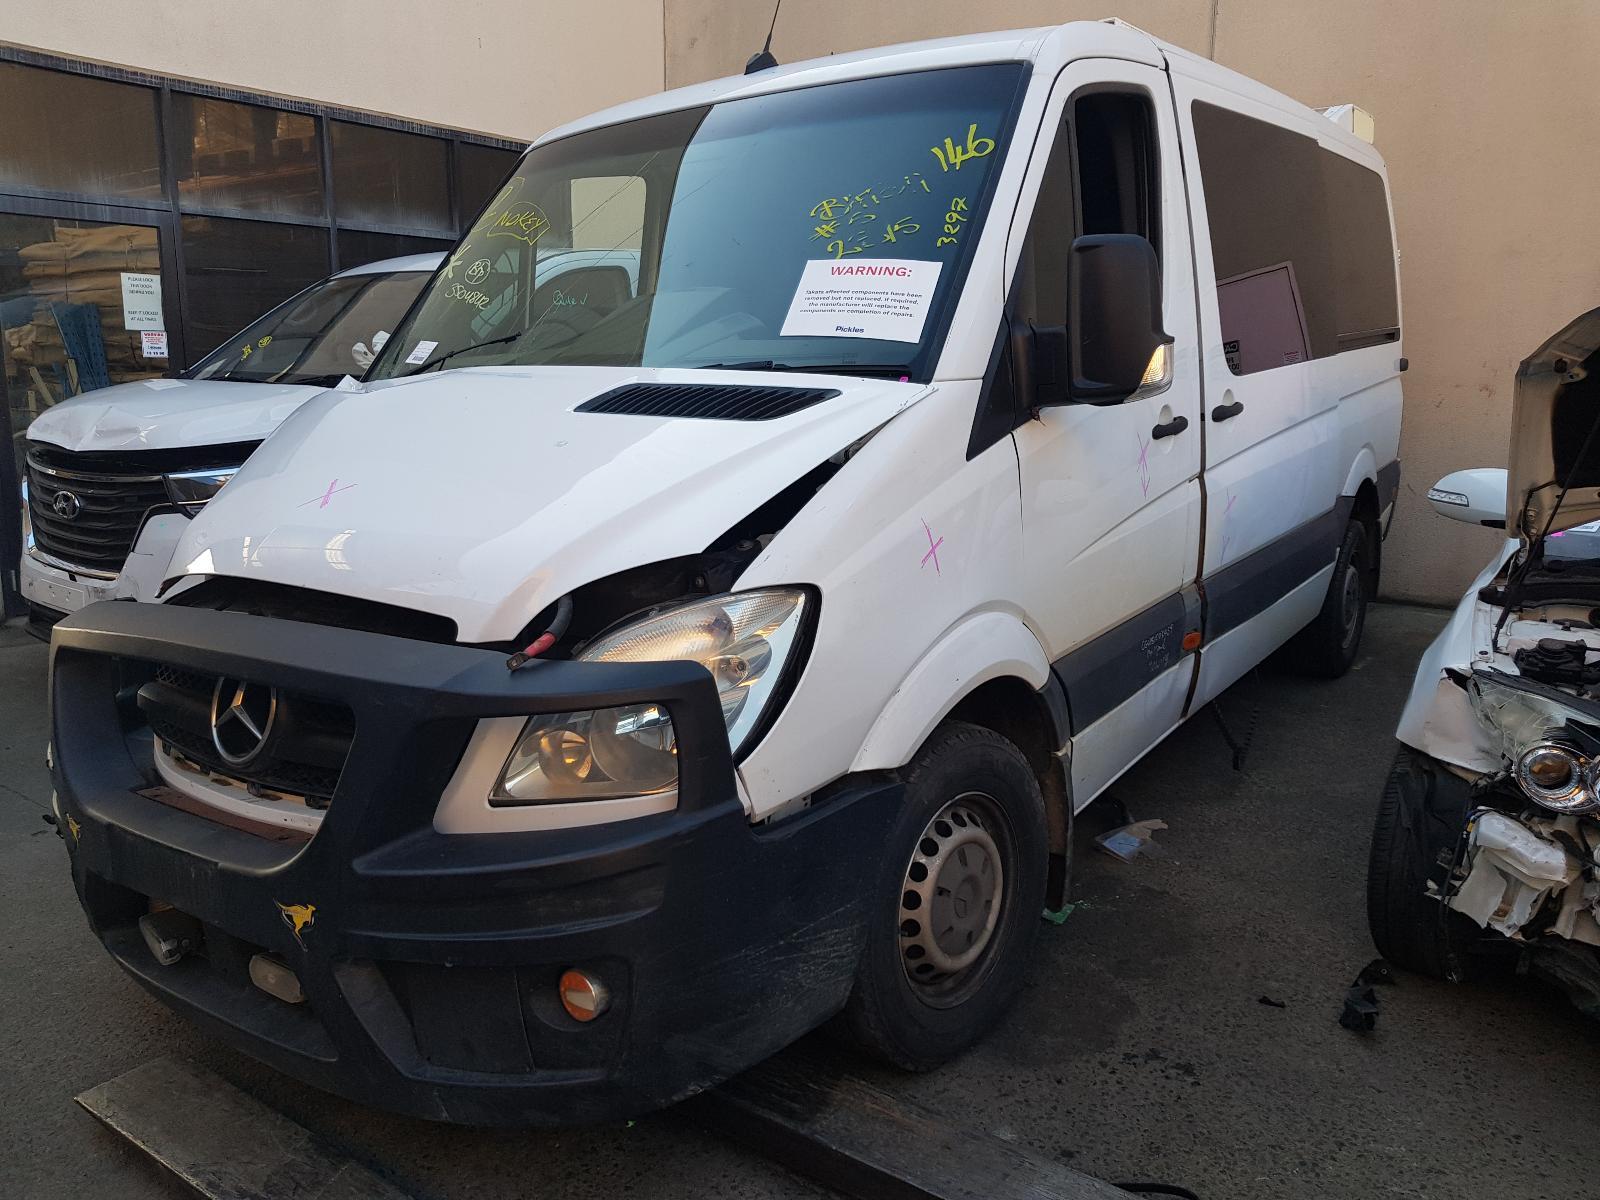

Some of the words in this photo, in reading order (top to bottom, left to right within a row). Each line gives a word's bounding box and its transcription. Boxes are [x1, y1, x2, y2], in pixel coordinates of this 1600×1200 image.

[931, 124, 995, 172] 146
[831, 266, 912, 277] WARNING:
[834, 325, 865, 334] Pickles
